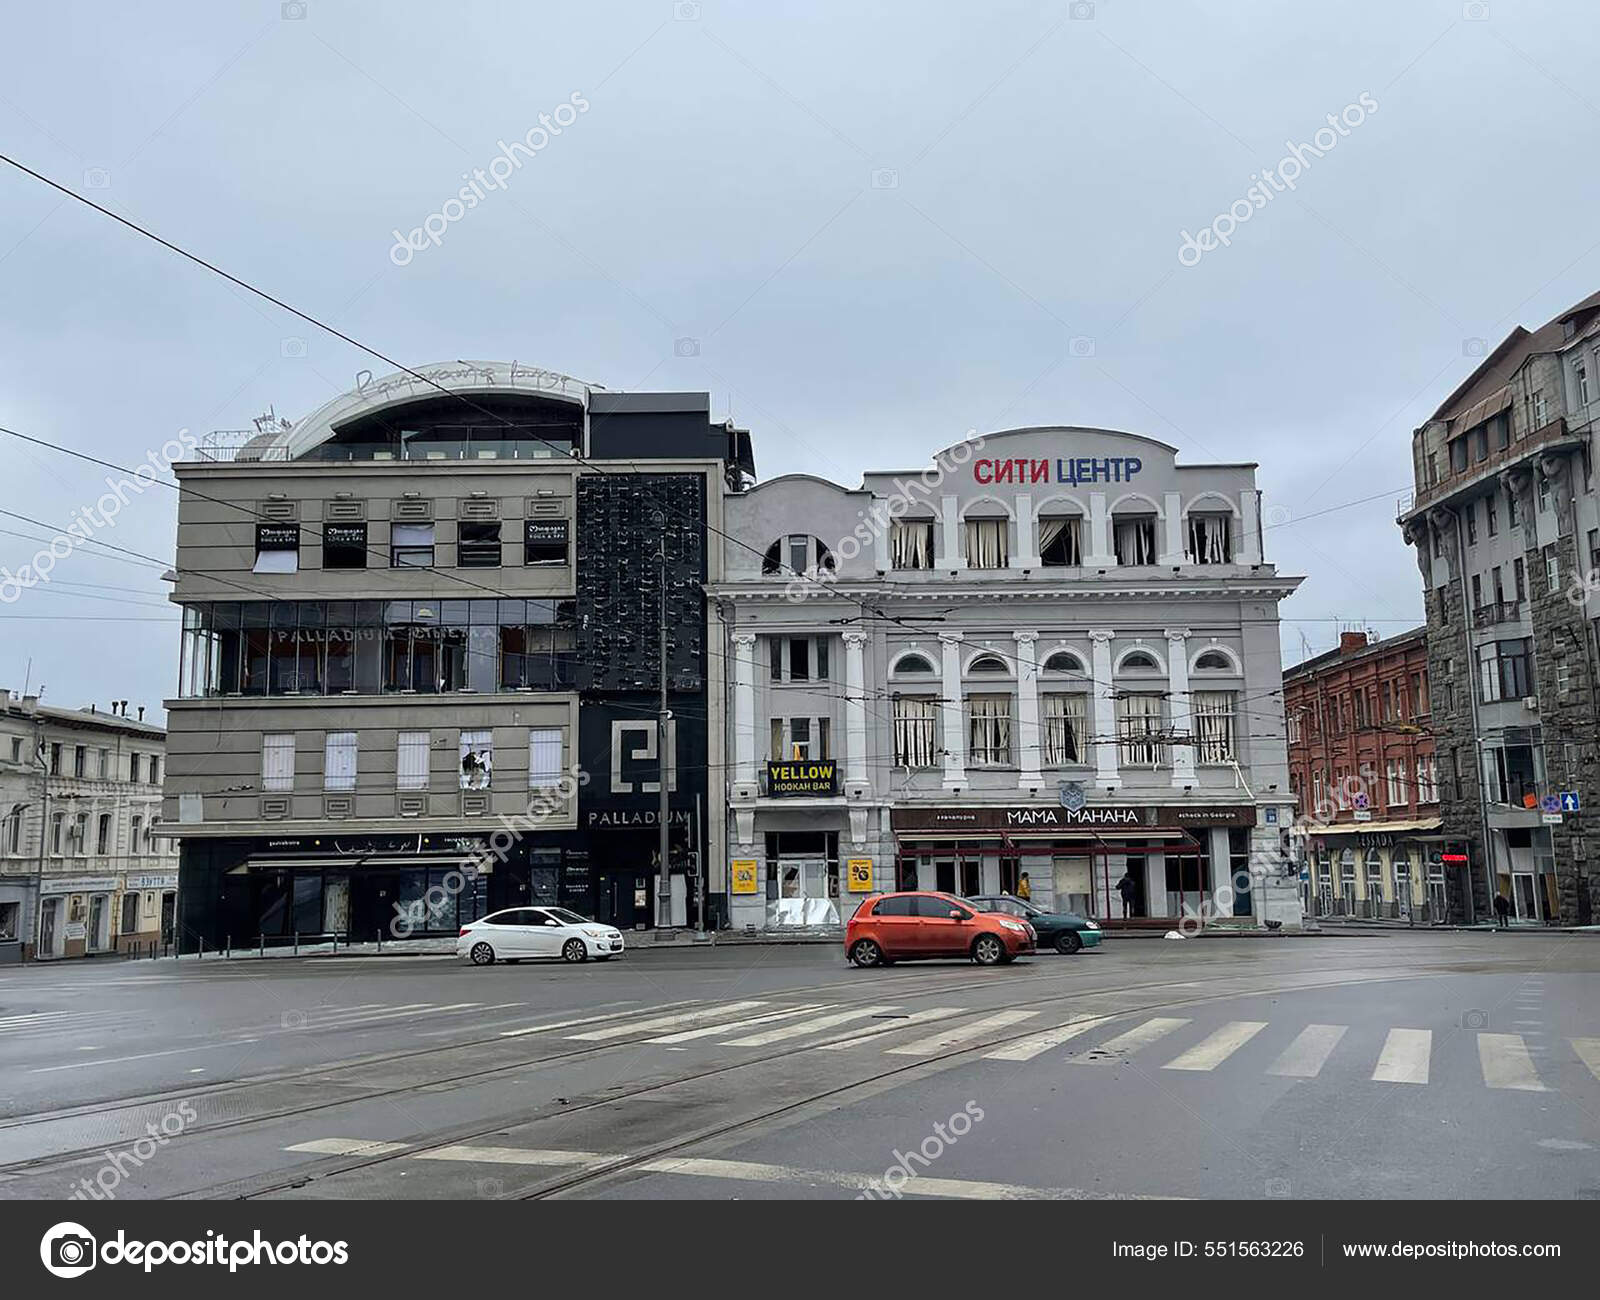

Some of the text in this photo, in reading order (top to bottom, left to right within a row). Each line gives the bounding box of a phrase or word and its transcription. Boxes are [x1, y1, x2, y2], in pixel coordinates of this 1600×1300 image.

[974, 458, 1142, 487] СИТИ ЦЕНТР
[771, 765, 833, 780] YELLOW
[774, 782, 831, 791] HOOKAH BAR
[1007, 809, 1139, 824] МАМА МАНАНА
